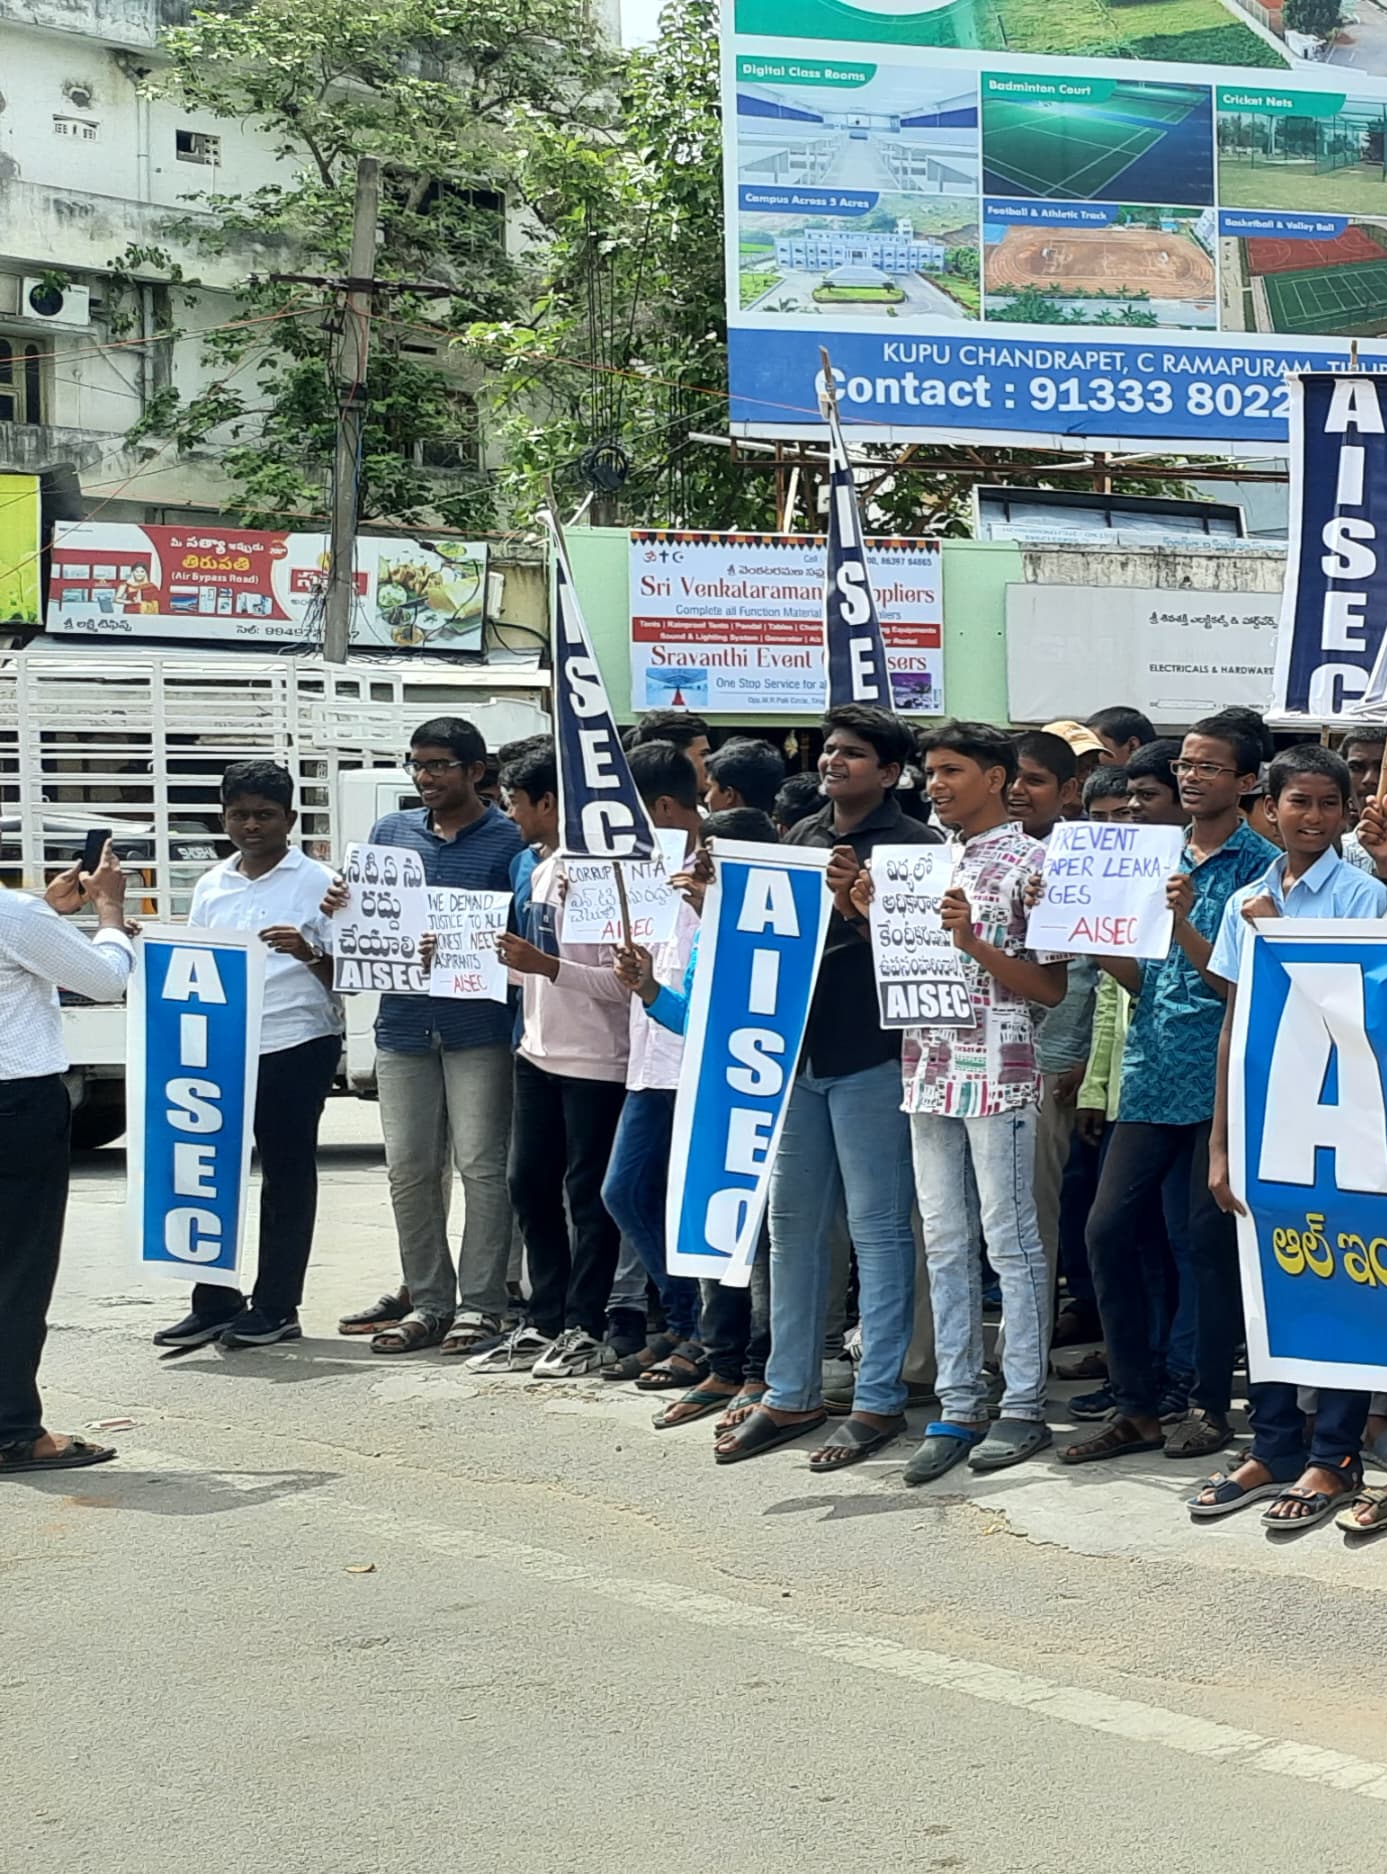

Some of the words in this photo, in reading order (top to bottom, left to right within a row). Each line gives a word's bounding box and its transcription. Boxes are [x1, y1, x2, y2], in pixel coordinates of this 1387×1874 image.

[743, 64, 785, 77] Digital
[789, 66, 820, 78] Class
[825, 69, 865, 81] Rooms
[989, 80, 1055, 94] Badminton
[1059, 84, 1092, 96] Court
[1223, 94, 1263, 106] Cricket
[1266, 96, 1293, 108] Nets
[745, 193, 789, 206] Campus
[791, 196, 826, 207] Across
[838, 199, 870, 209] Acres
[988, 206, 1028, 217] Football
[1030, 208, 1038, 217] &
[1041, 209, 1078, 220] Athletic
[1080, 211, 1107, 221] Track
[1225, 218, 1274, 229] Basketball
[1276, 220, 1284, 229] &
[1316, 222, 1334, 232] Ball
[883, 343, 951, 365] KUPU
[959, 346, 1128, 374] CHANDRAPET,
[1137, 352, 1155, 373] C
[814, 367, 991, 408] Contact
[1029, 377, 1173, 415] 91333
[1187, 382, 1291, 418] 8022
[182, 555, 251, 570] తిరుపతి
[171, 572, 191, 583] (Air
[192, 572, 226, 585] Bypass
[229, 574, 259, 584] Road)
[640, 575, 671, 598] Sri
[680, 576, 823, 600] Venkataraman
[676, 604, 722, 617] Complete
[725, 606, 737, 616] all
[739, 606, 780, 617] Function
[784, 608, 822, 618] Material
[660, 632, 687, 641] Sound
[696, 633, 728, 643] Lighting
[730, 634, 759, 643] System
[651, 645, 748, 668] Sravanthi
[757, 647, 811, 668] Event
[1149, 664, 1209, 674] ELECTRICALS
[1212, 666, 1218, 674] &
[716, 678, 736, 689] One
[738, 678, 761, 691] Stop
[764, 678, 801, 690] Service
[803, 679, 817, 689] for
[1053, 826, 1139, 851] PREVENT
[632, 862, 667, 881] NTA
[428, 893, 444, 911] WE
[450, 893, 494, 912] DEMAND
[1048, 885, 1092, 905] GES
[361, 890, 402, 931] రద్దు
[428, 914, 464, 930] JUSTICE
[468, 914, 482, 929] TO
[485, 913, 505, 928] ALL
[601, 916, 655, 940] AIEC
[1068, 916, 1138, 945] AISEC
[339, 923, 416, 959] చేయాలి
[470, 930, 497, 951] NEET
[434, 952, 482, 970] ASPIRANTS
[340, 959, 430, 992] AISEC
[454, 972, 488, 993] AISEC
[886, 983, 971, 1019] AISEC
[161, 947, 227, 1263] AISEC
[1271, 1212, 1335, 1278] ఆల్
